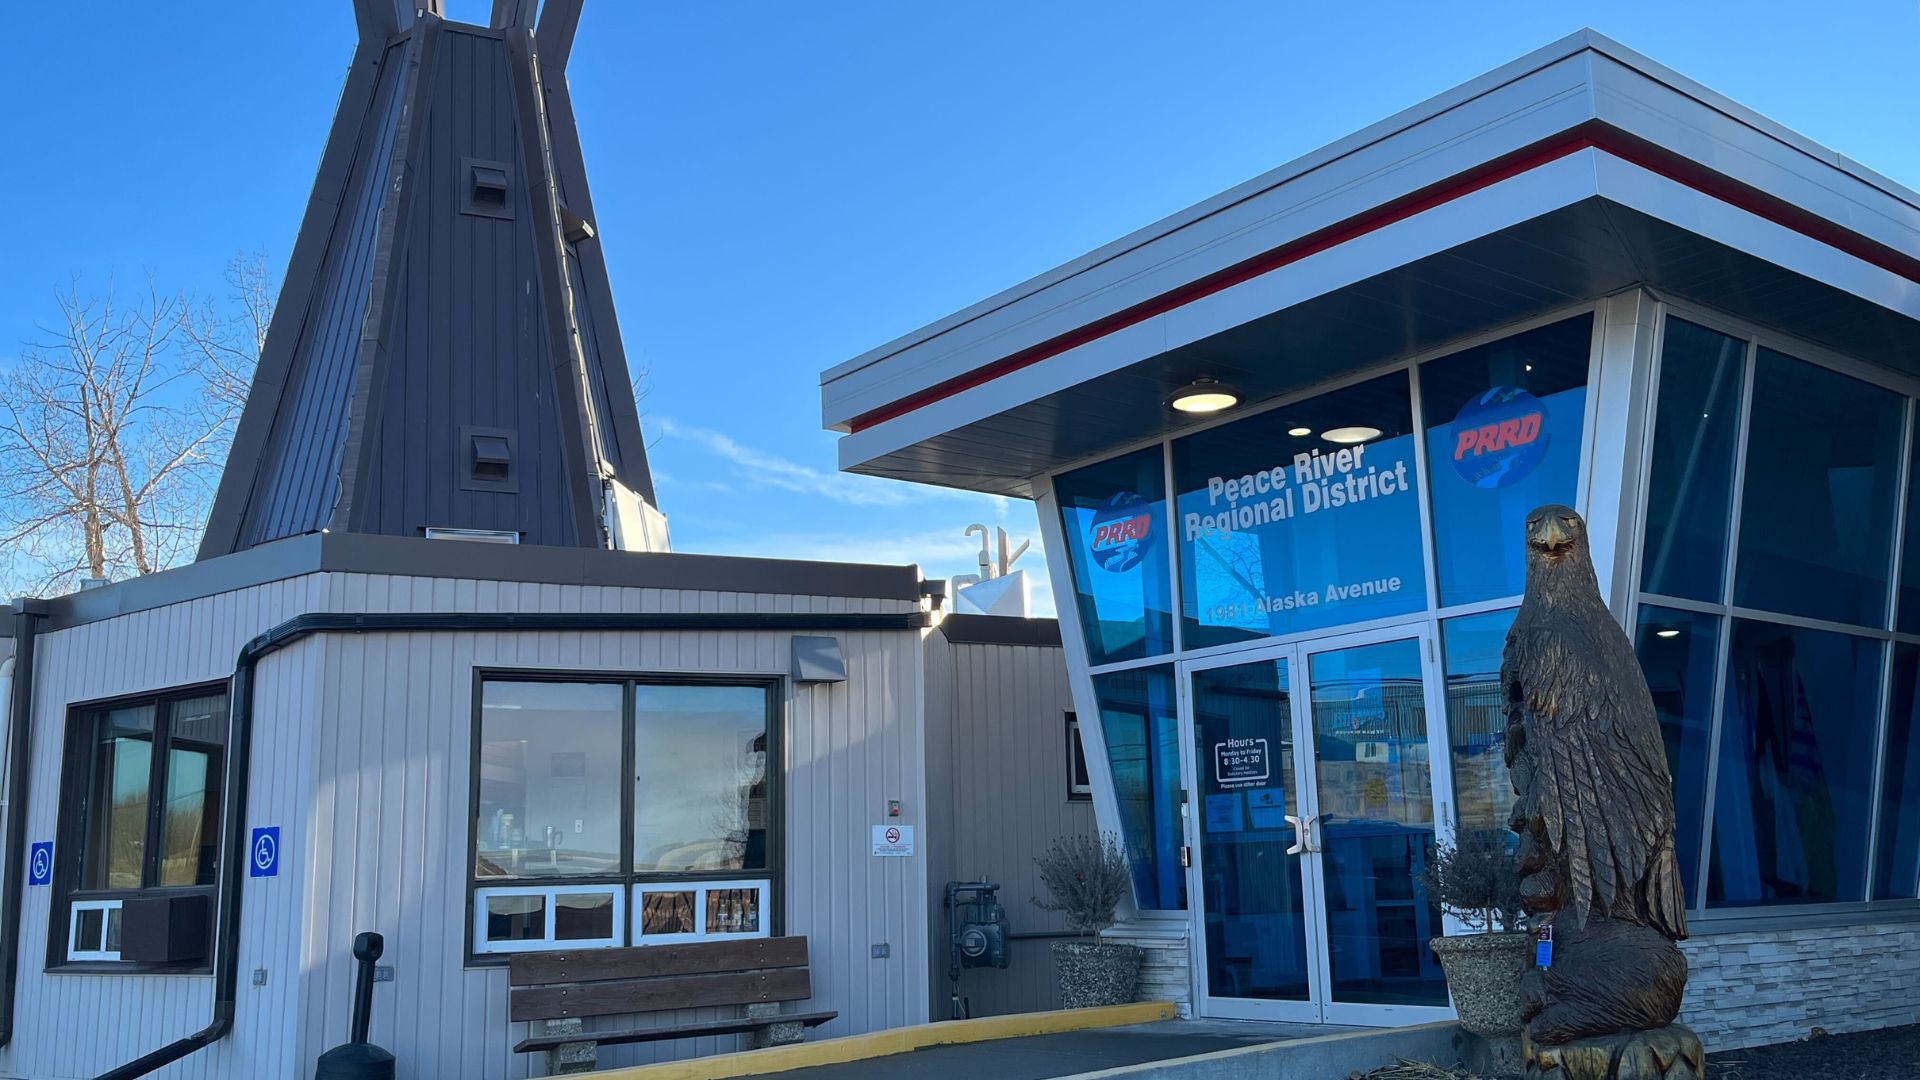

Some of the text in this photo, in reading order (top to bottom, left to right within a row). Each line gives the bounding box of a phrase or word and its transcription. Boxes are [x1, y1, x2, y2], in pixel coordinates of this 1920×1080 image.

[1454, 411, 1542, 461] PRRD
[1207, 444, 1365, 506] Peace River
[1185, 460, 1408, 541] Regional District
[1093, 513, 1151, 549] PRRD
[1255, 590, 1319, 614] Alaska
[1325, 576, 1401, 603] Avenue
[1227, 738, 1254, 748] Hours
